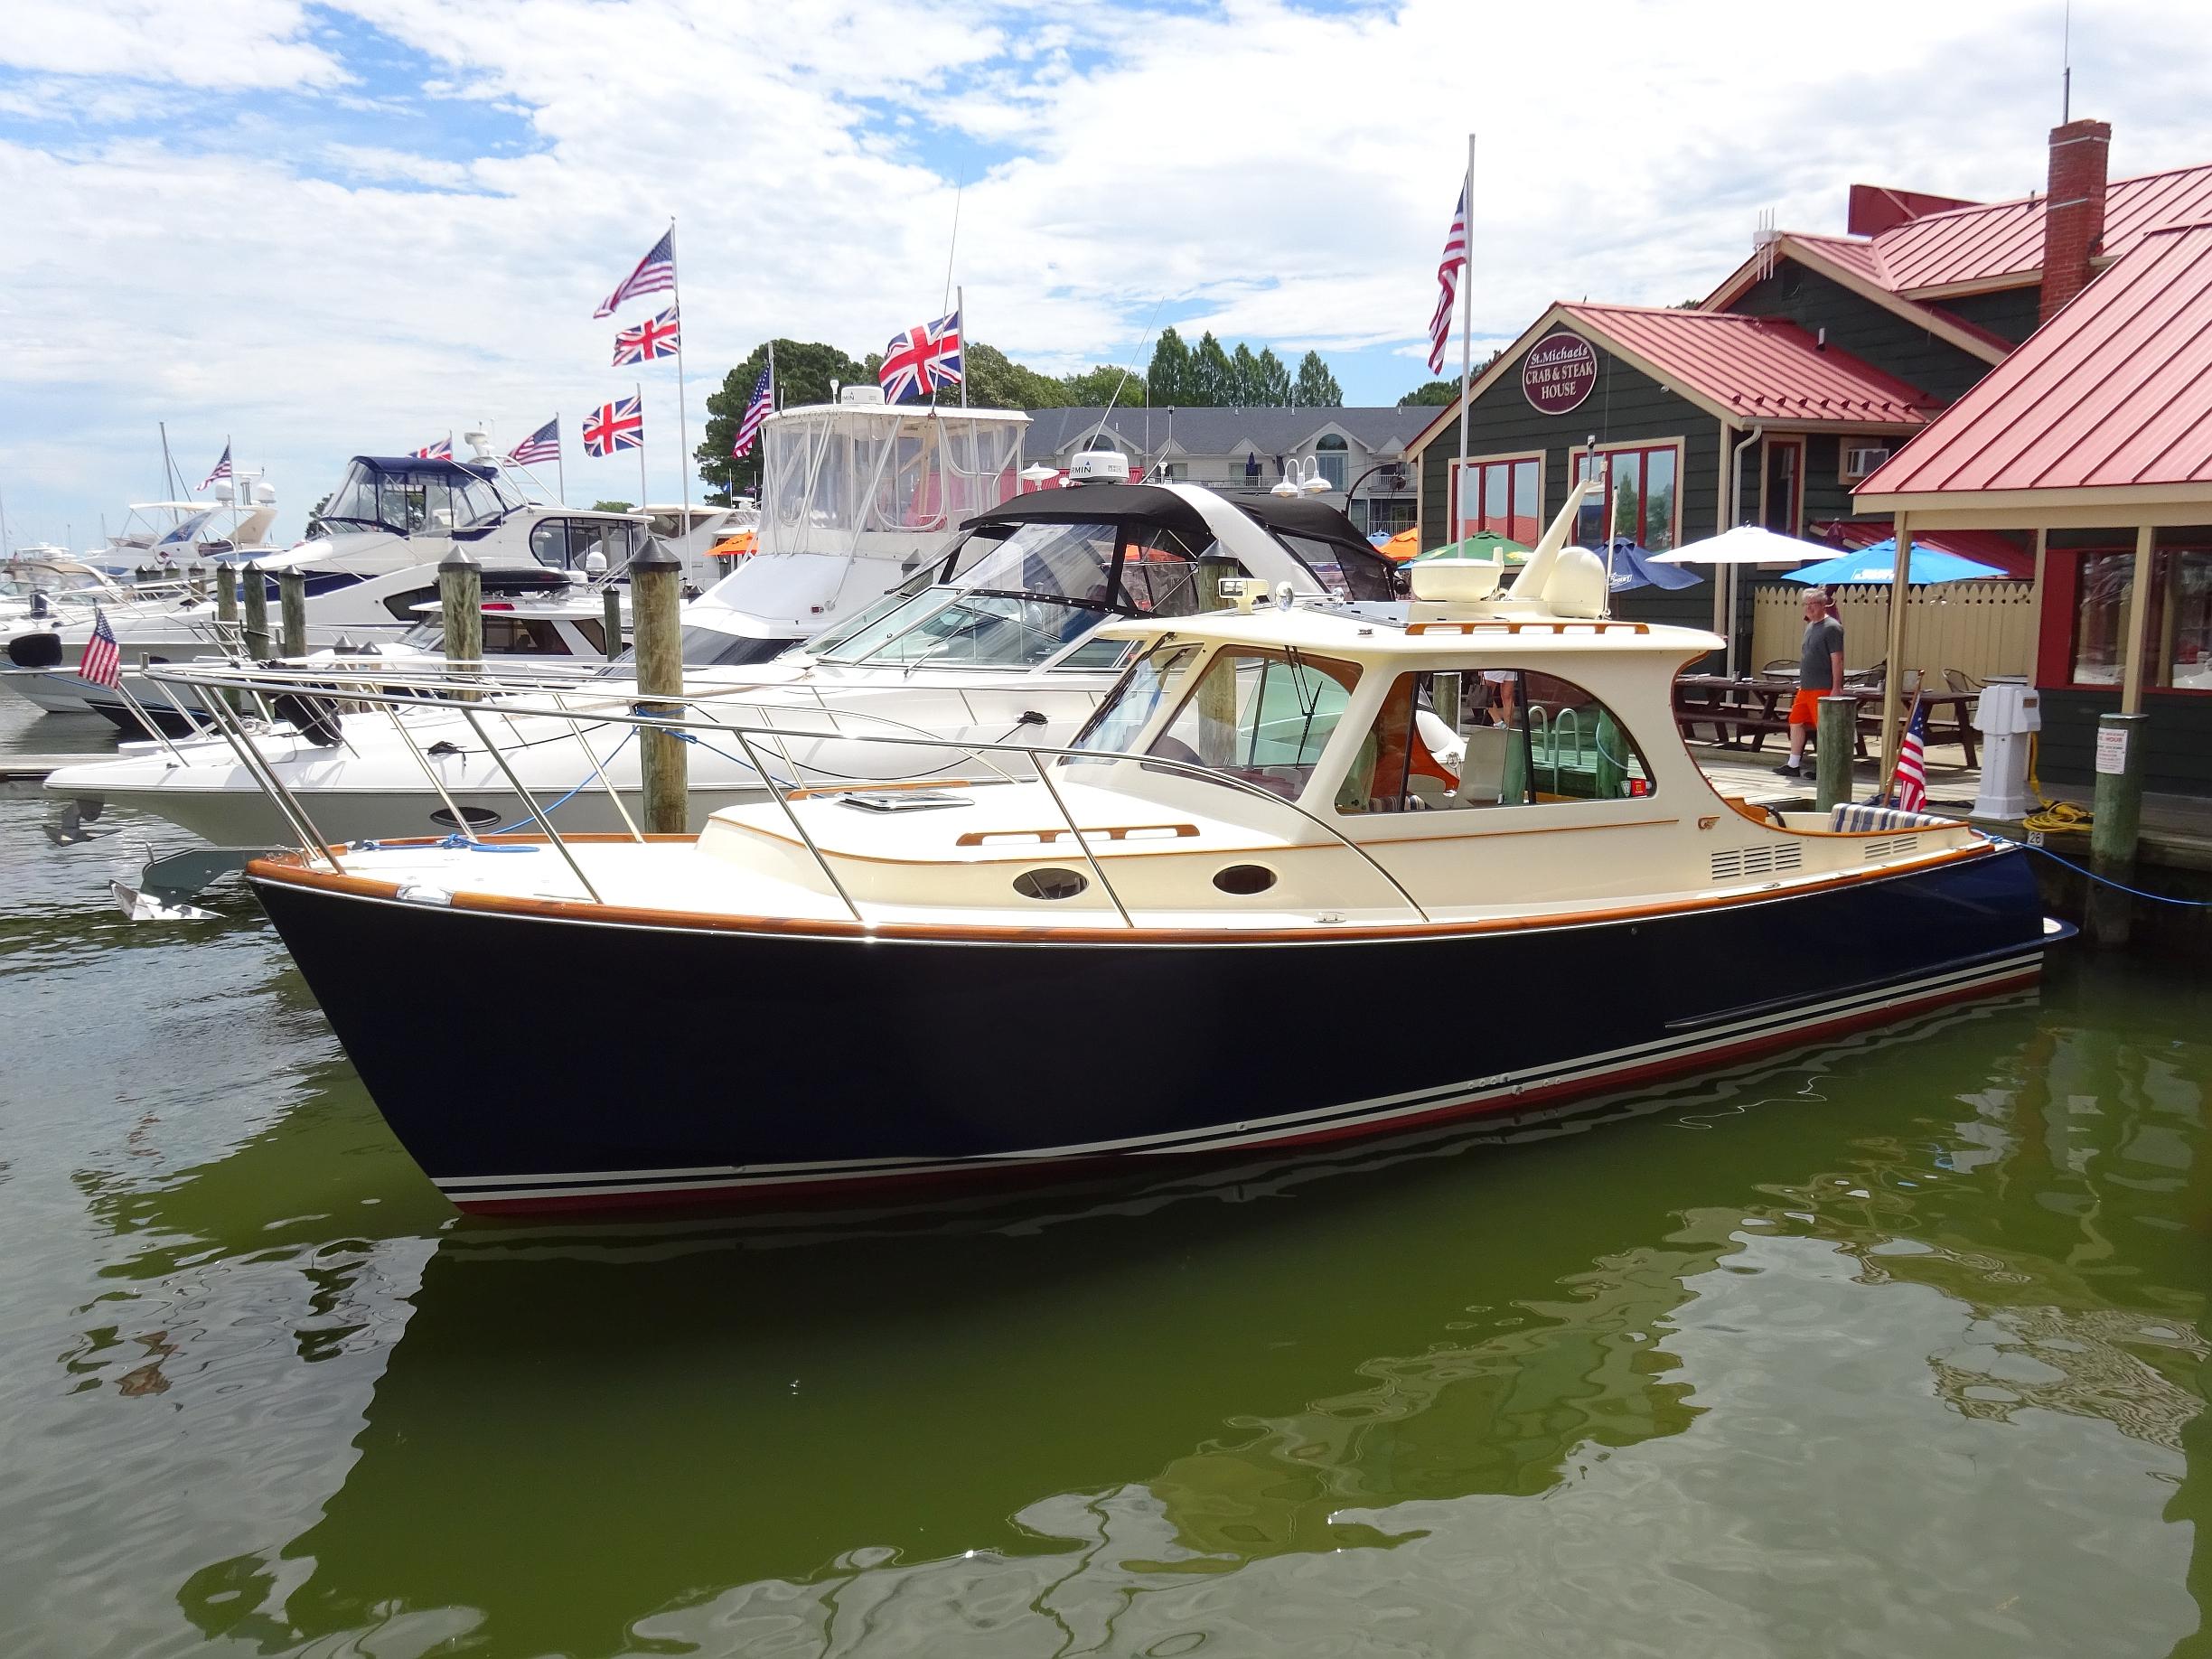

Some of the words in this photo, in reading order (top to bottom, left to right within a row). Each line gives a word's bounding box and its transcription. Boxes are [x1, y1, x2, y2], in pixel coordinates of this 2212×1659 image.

[1525, 368, 1551, 385] CRAB
[1552, 366, 1561, 380] &
[1561, 361, 1593, 380] STEAK
[1541, 381, 1576, 399] HOUSE
